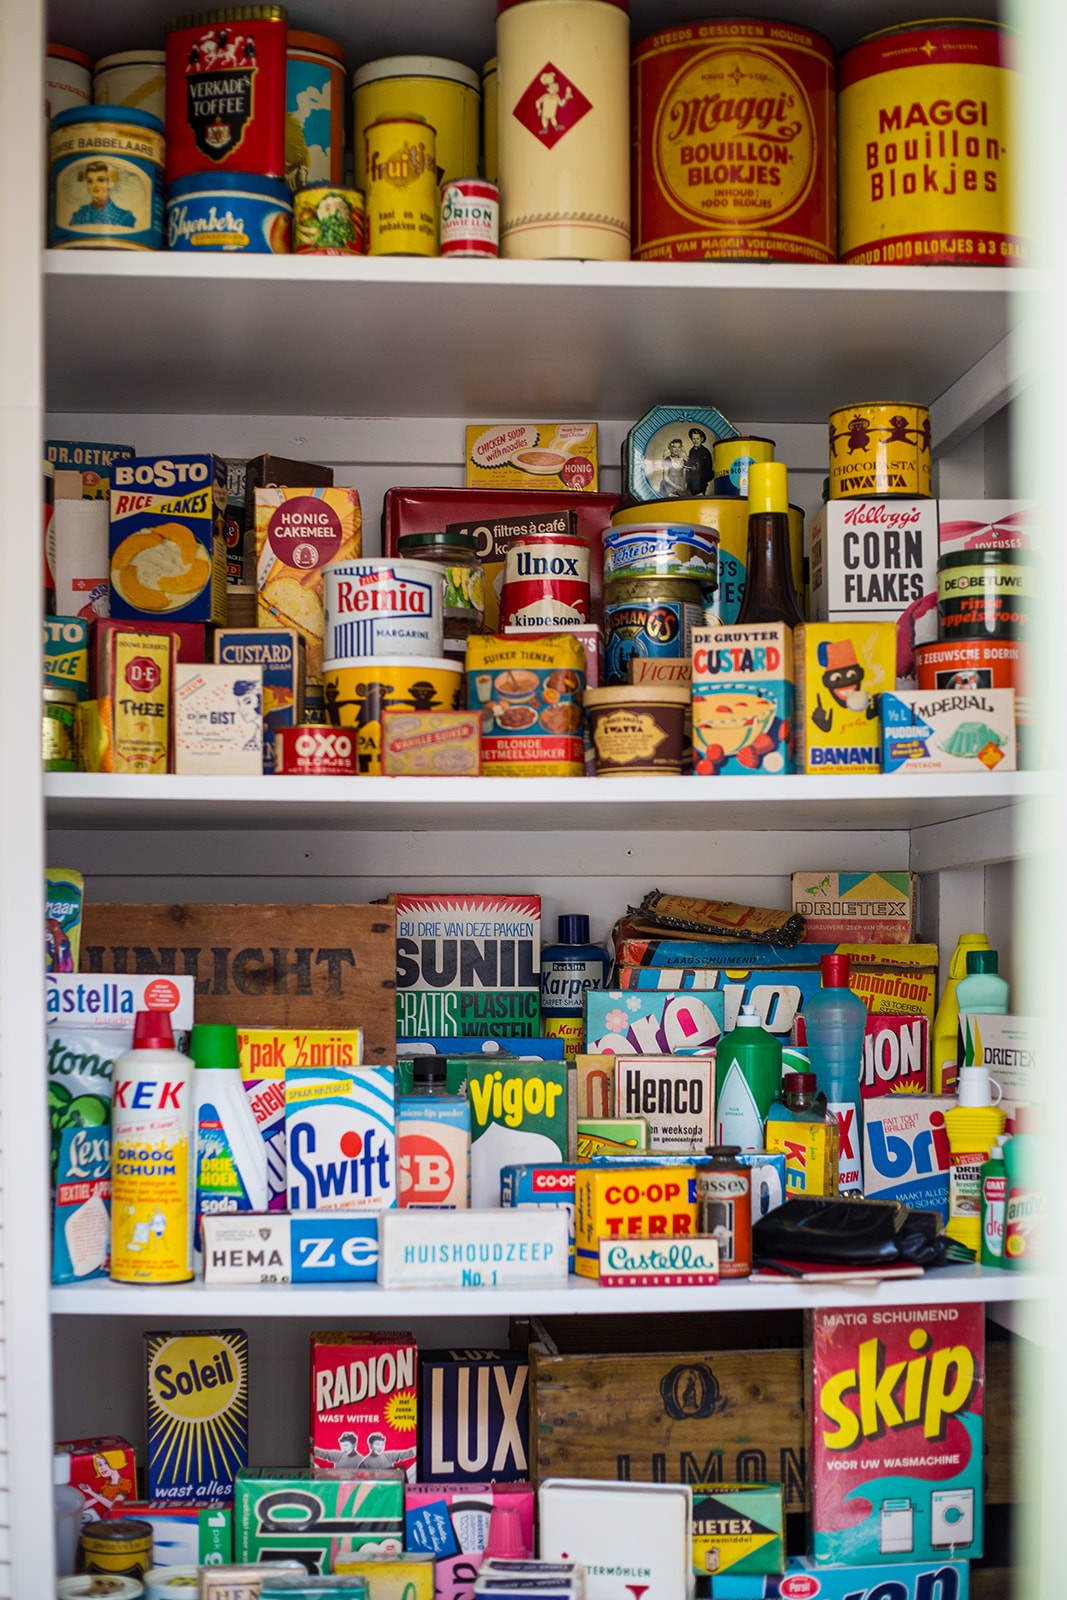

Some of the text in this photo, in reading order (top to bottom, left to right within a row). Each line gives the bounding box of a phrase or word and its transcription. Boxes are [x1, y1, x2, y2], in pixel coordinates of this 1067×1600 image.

[653, 25, 813, 48] STEEDS GESLOTEN HOUDEN
[194, 97, 244, 117] TOFFEE
[879, 99, 988, 134] MAGGI
[77, 137, 154, 157] BABBELAARS
[680, 142, 793, 166] BOUILLON-
[866, 130, 1006, 170] Bouillon-
[688, 165, 781, 187] BLOKJES
[871, 163, 998, 202] Blokjes
[443, 200, 492, 221] ORION
[701, 199, 772, 209] 1000 BLOKJES
[676, 241, 697, 251] VAN
[883, 239, 996, 261] 1000 BLOKJES 3
[477, 427, 526, 455] CHICKEN SOUP
[486, 439, 528, 462] with noodles
[115, 460, 208, 488] BOSTO
[565, 464, 592, 473] HONIG
[833, 461, 915, 477] CHOCOPASTA
[115, 493, 209, 515] RICE FLAKES
[281, 513, 328, 525] HONIG
[844, 504, 921, 529] Kellogg's
[275, 528, 336, 538] CAKEMEEL
[494, 517, 566, 538] filtres à café
[843, 530, 923, 570] CORN
[844, 573, 924, 603] FLAKES
[945, 579, 957, 591] DE
[337, 581, 425, 614] Remia
[377, 629, 430, 640] MARGARINE
[694, 631, 779, 644] DE GRUYTER
[222, 645, 292, 663] CUSTARD
[484, 651, 555, 666] SUIKER TIENEN
[693, 646, 780, 674] CUSTARD
[267, 664, 292, 672] GRAM
[120, 699, 165, 718] THEE
[901, 709, 908, 721] L
[909, 696, 996, 726] IMPERIAL
[210, 712, 235, 725] GIST
[885, 726, 930, 740] PUDDING
[295, 733, 352, 757] OXO
[497, 740, 542, 750] BLONDE
[297, 757, 352, 767] BLOKJES
[906, 761, 942, 770] PISTACHE
[796, 901, 907, 917] DRIETEX
[400, 922, 534, 937] BIJ DRIE VAN DEZE PAKKEN
[396, 938, 541, 988] SUNIL
[541, 972, 601, 998] Karpex
[396, 992, 537, 1037] GRATIS PLASTIC
[881, 1000, 891, 1008] 33
[891, 1001, 922, 1013] TOEREN
[250, 1037, 353, 1073] pak prijs
[113, 1080, 185, 1111] KEK
[470, 1070, 563, 1128] Vigor
[626, 1069, 703, 1115] Henco
[883, 1113, 920, 1126] FAIT TOUT
[884, 1121, 916, 1133] BRILLER
[661, 1123, 703, 1136] weeksoda
[662, 1135, 703, 1144] geconcentreerd
[118, 1149, 174, 1161] DROOG
[115, 1164, 176, 1176] SCHUIM
[201, 1158, 233, 1172] DRIE
[290, 1122, 390, 1210] Swift
[200, 1172, 238, 1187] HOEK
[895, 1190, 923, 1201] MAAKT
[924, 1187, 949, 1198] ALLES
[201, 1196, 238, 1213] soda
[212, 1250, 283, 1267] HEMA
[300, 1236, 379, 1268] ze
[405, 1243, 554, 1264] HUISHOUDZEEP
[608, 1245, 714, 1271] Castella
[260, 1274, 277, 1284] 25
[462, 1269, 498, 1287] No. 1
[608, 1275, 715, 1287] SCHEERZEEP
[823, 1309, 959, 1326] MATIG SCHUIMEND
[449, 1350, 500, 1361] LUX
[154, 1350, 234, 1401] Soleil
[316, 1347, 413, 1412] RADION
[819, 1328, 976, 1450] skip
[318, 1414, 379, 1423] WAST WITTER
[431, 1364, 530, 1475] LUX
[826, 1454, 960, 1471] VOOR UW WASMACHINE
[155, 1480, 232, 1498] wast alles
